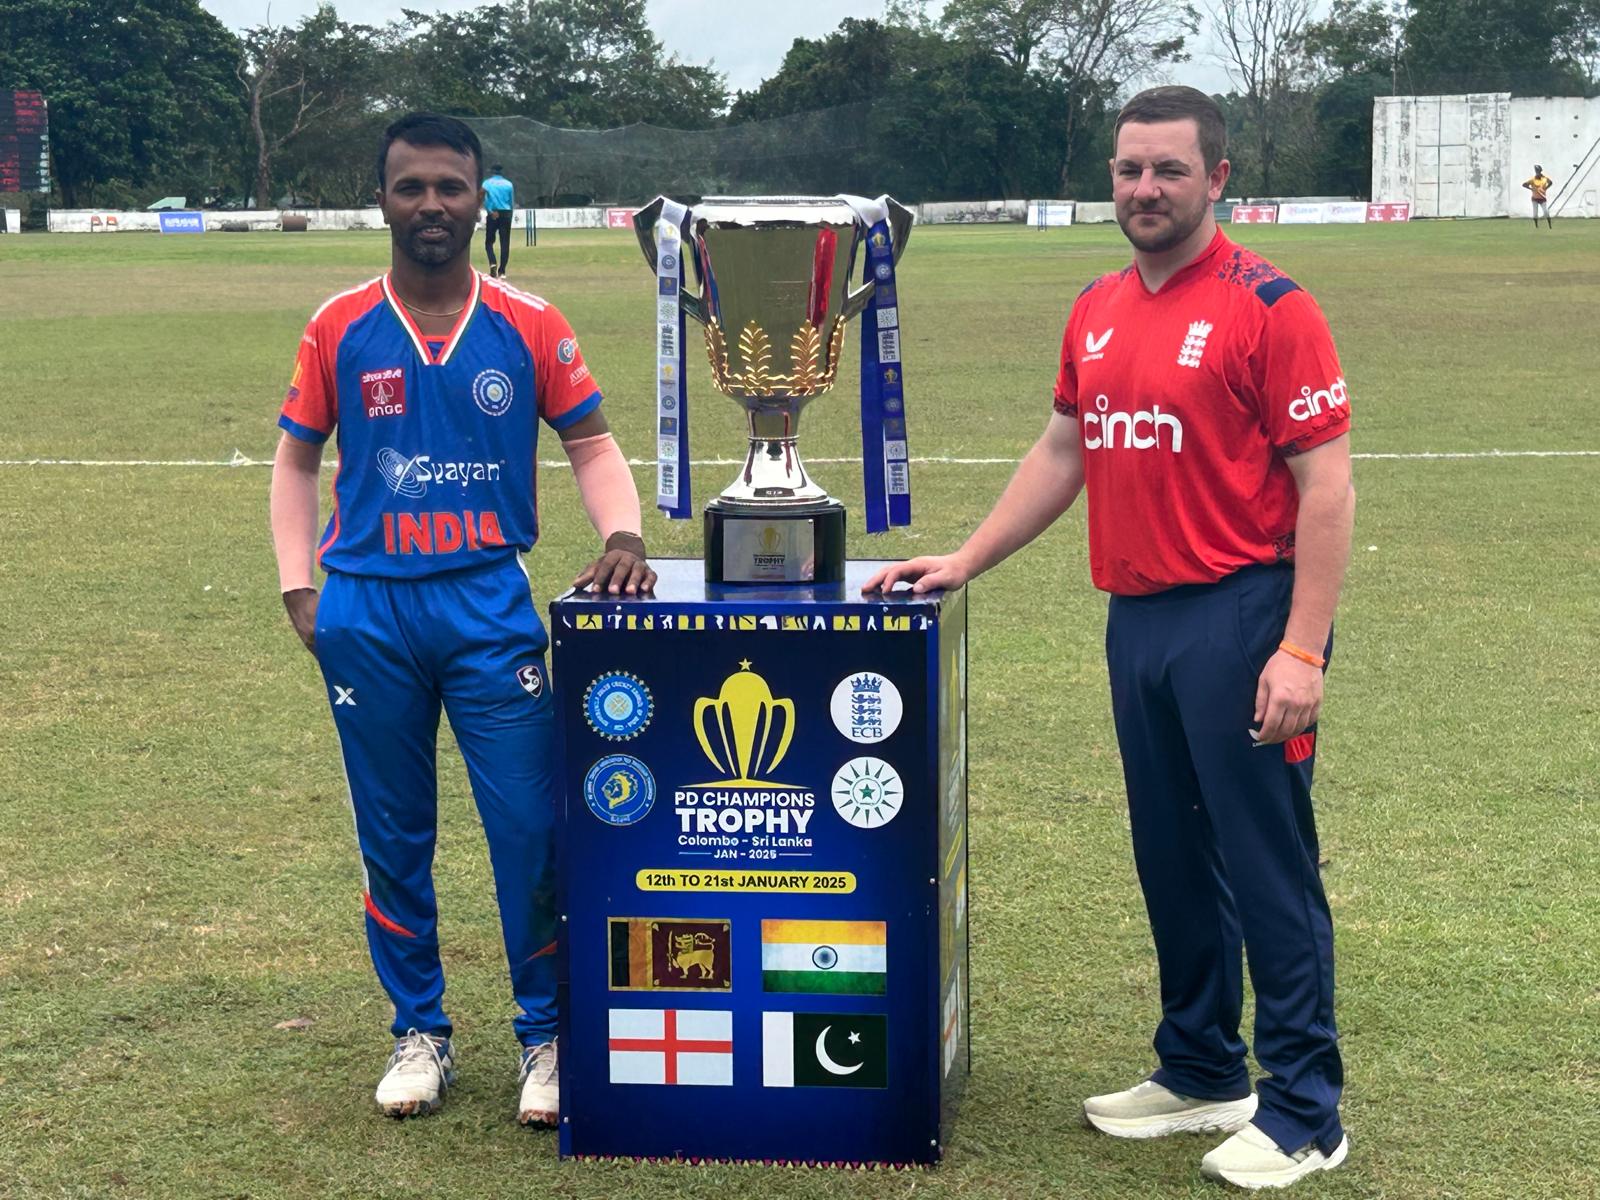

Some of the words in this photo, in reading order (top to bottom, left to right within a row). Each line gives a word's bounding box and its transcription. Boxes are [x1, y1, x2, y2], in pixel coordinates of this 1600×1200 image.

[1084, 394, 1183, 453] cinch
[382, 509, 507, 555] INDIA
[851, 726, 883, 738] ECB
[674, 791, 699, 806] PD
[702, 791, 816, 807] CHAMPIONS
[675, 807, 814, 834] TROPHY
[677, 834, 740, 847] Colombo
[751, 834, 770, 847] Sri
[771, 835, 813, 847] Lanka
[713, 848, 739, 859] JAN
[748, 849, 777, 859] 2025
[645, 874, 676, 887] 12th
[679, 874, 701, 887] TO
[703, 874, 735, 887] 21st
[737, 875, 810, 889] JANUARY
[812, 876, 847, 889] 2025
